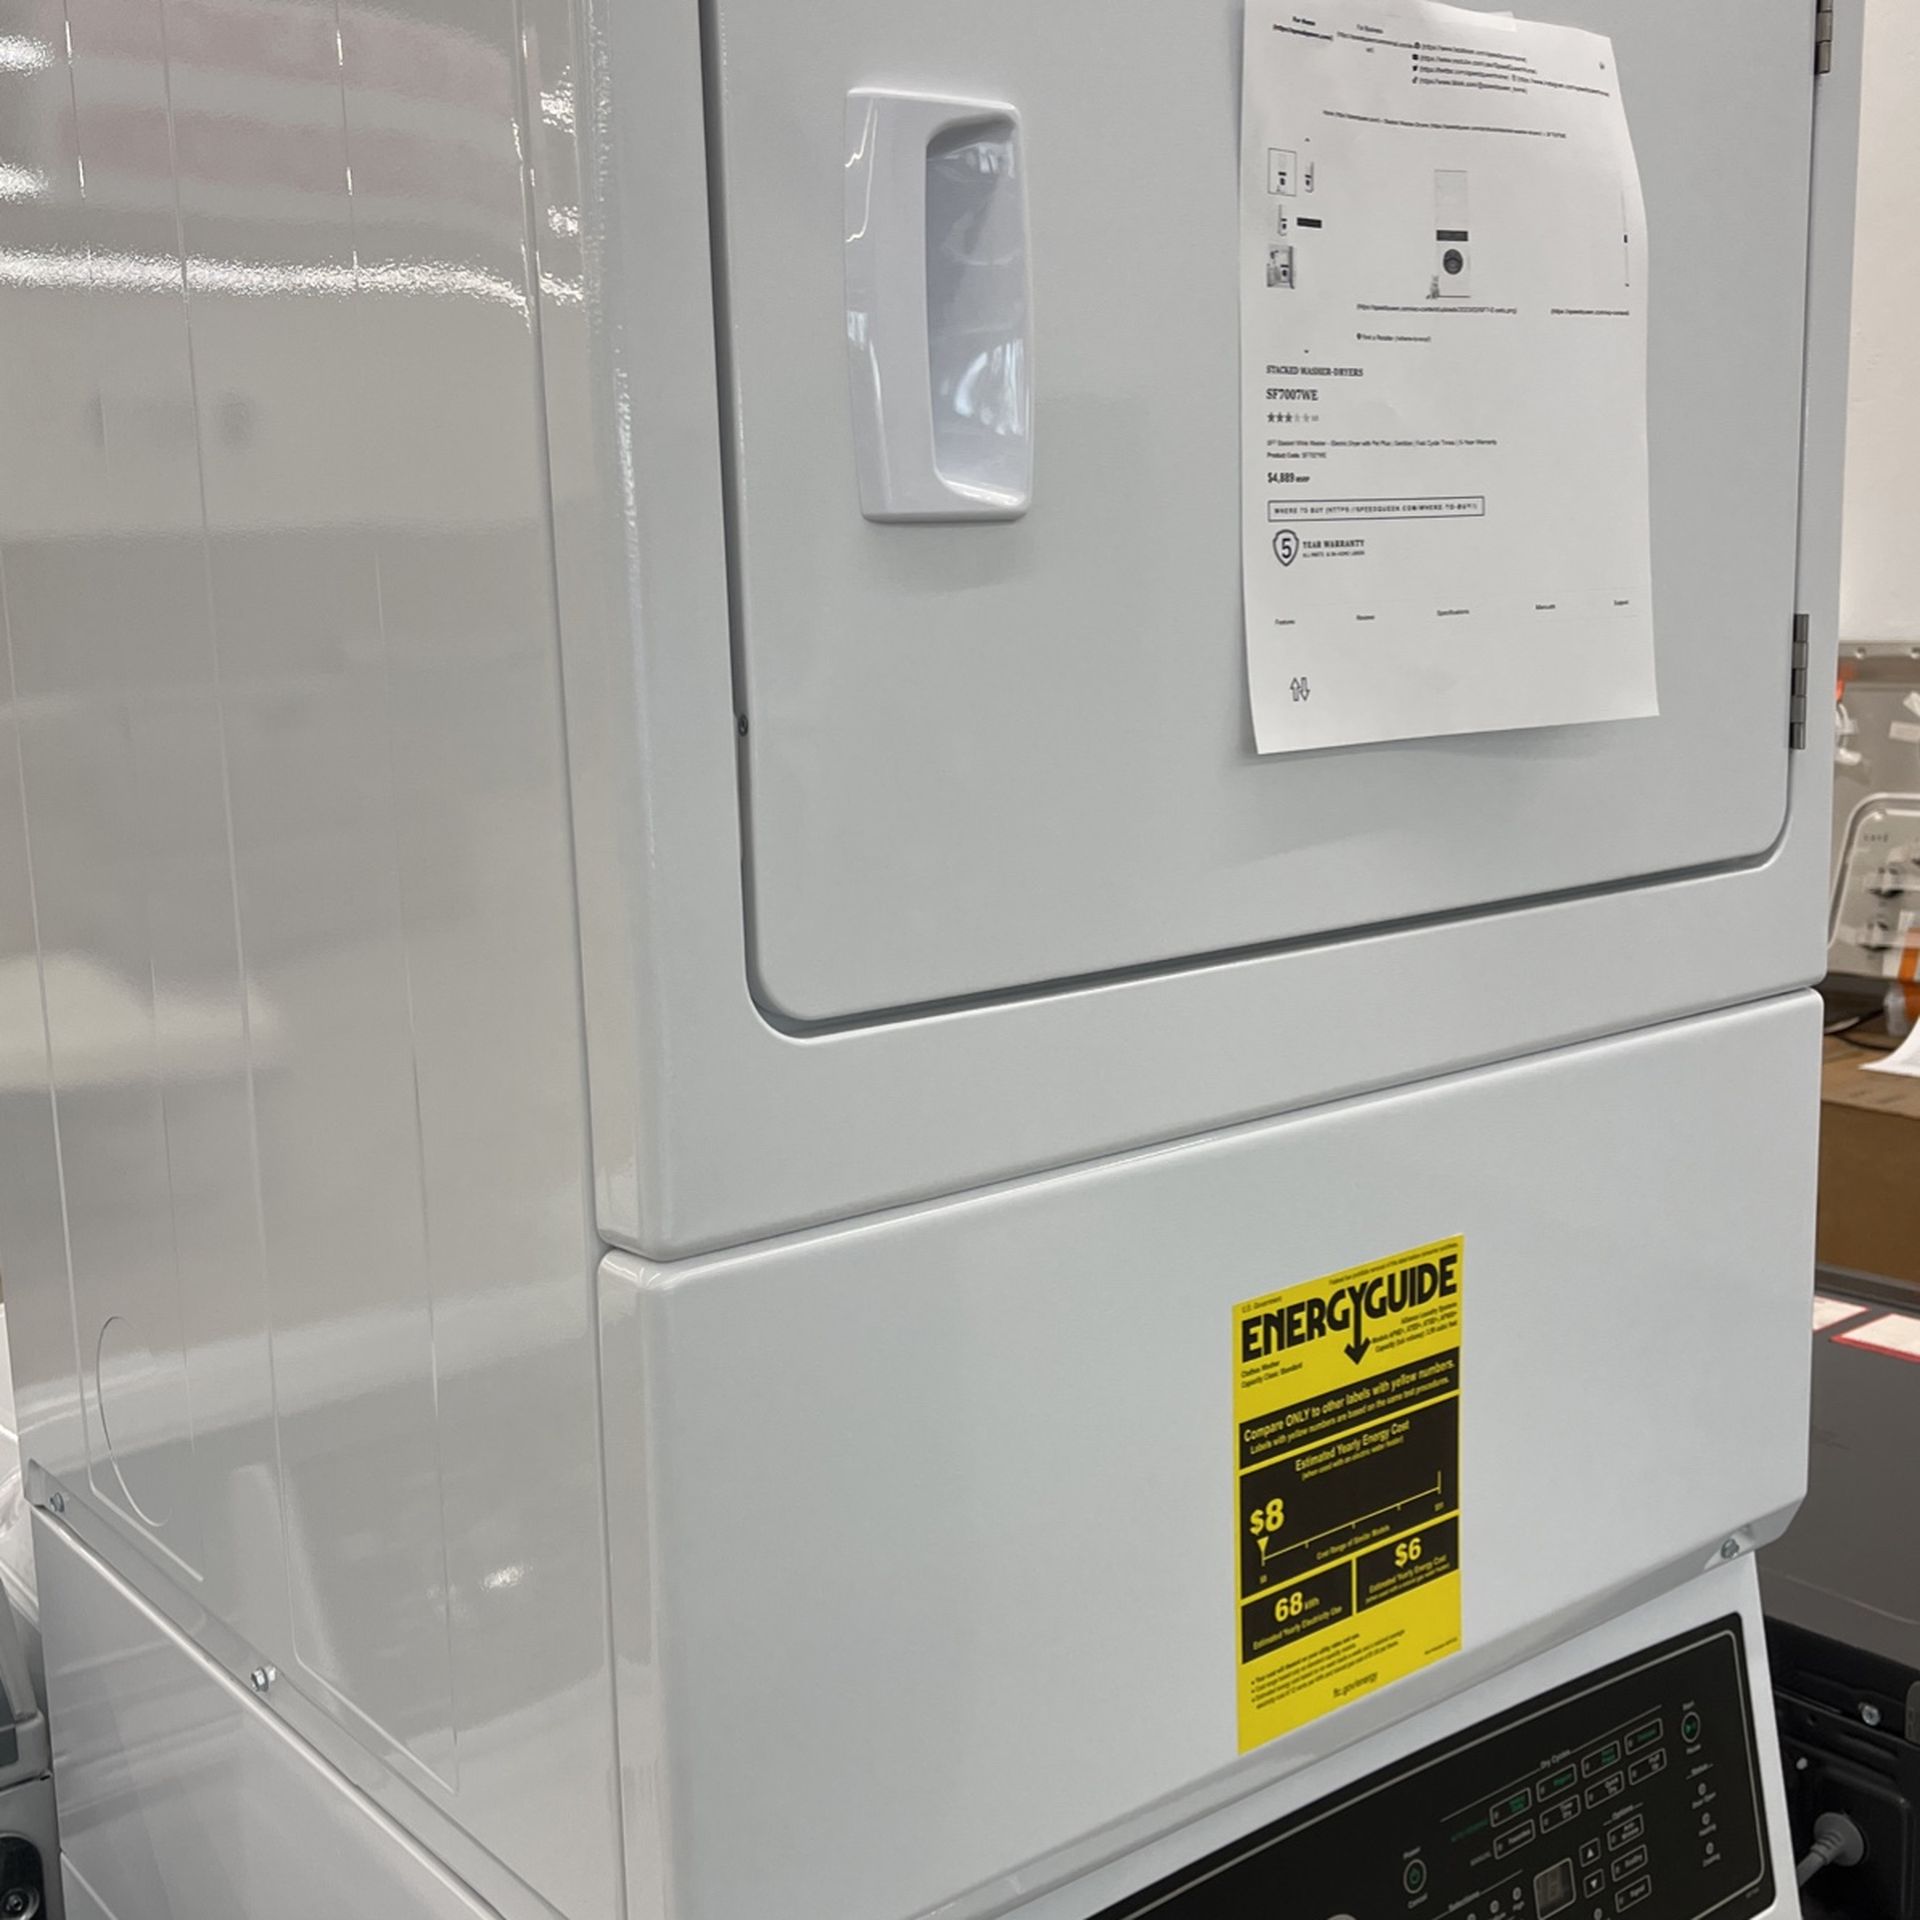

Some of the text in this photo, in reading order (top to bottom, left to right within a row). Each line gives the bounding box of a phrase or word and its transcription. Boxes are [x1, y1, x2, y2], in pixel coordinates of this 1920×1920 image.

[1266, 365, 1363, 377] STACKED WASHER-DRYERS
[1265, 388, 1319, 401] SF7007WE
[1267, 472, 1295, 484] $4,889
[1281, 538, 1365, 559] 5 YEAR WARRANTY
[1241, 1253, 1458, 1366] ENERGYGUIDE
[1241, 1376, 1263, 1389] Capacity
[1243, 1359, 1456, 1443] Compare ONLY to other labels with yellow numbers.
[1249, 1440, 1273, 1455] Labels
[1273, 1434, 1287, 1446] with
[1287, 1427, 1309, 1443] yellow
[1308, 1417, 1337, 1433] numbers
[1295, 1419, 1410, 1472] Estimated Yearly Energy Cost
[1249, 1498, 1285, 1535] $8
[1394, 1537, 1422, 1568] $6
[1368, 1576, 1397, 1594] Estimated
[1413, 1561, 1434, 1574] Energy
[1432, 1554, 1447, 1566] Cost
[1275, 1591, 1304, 1622] 68
[1252, 1606, 1343, 1651] Estimated Yearly Electricity Use
[1333, 1671, 1379, 1698] ftc.gov/energy
[1539, 1749, 1571, 1770] Dry Cycles
